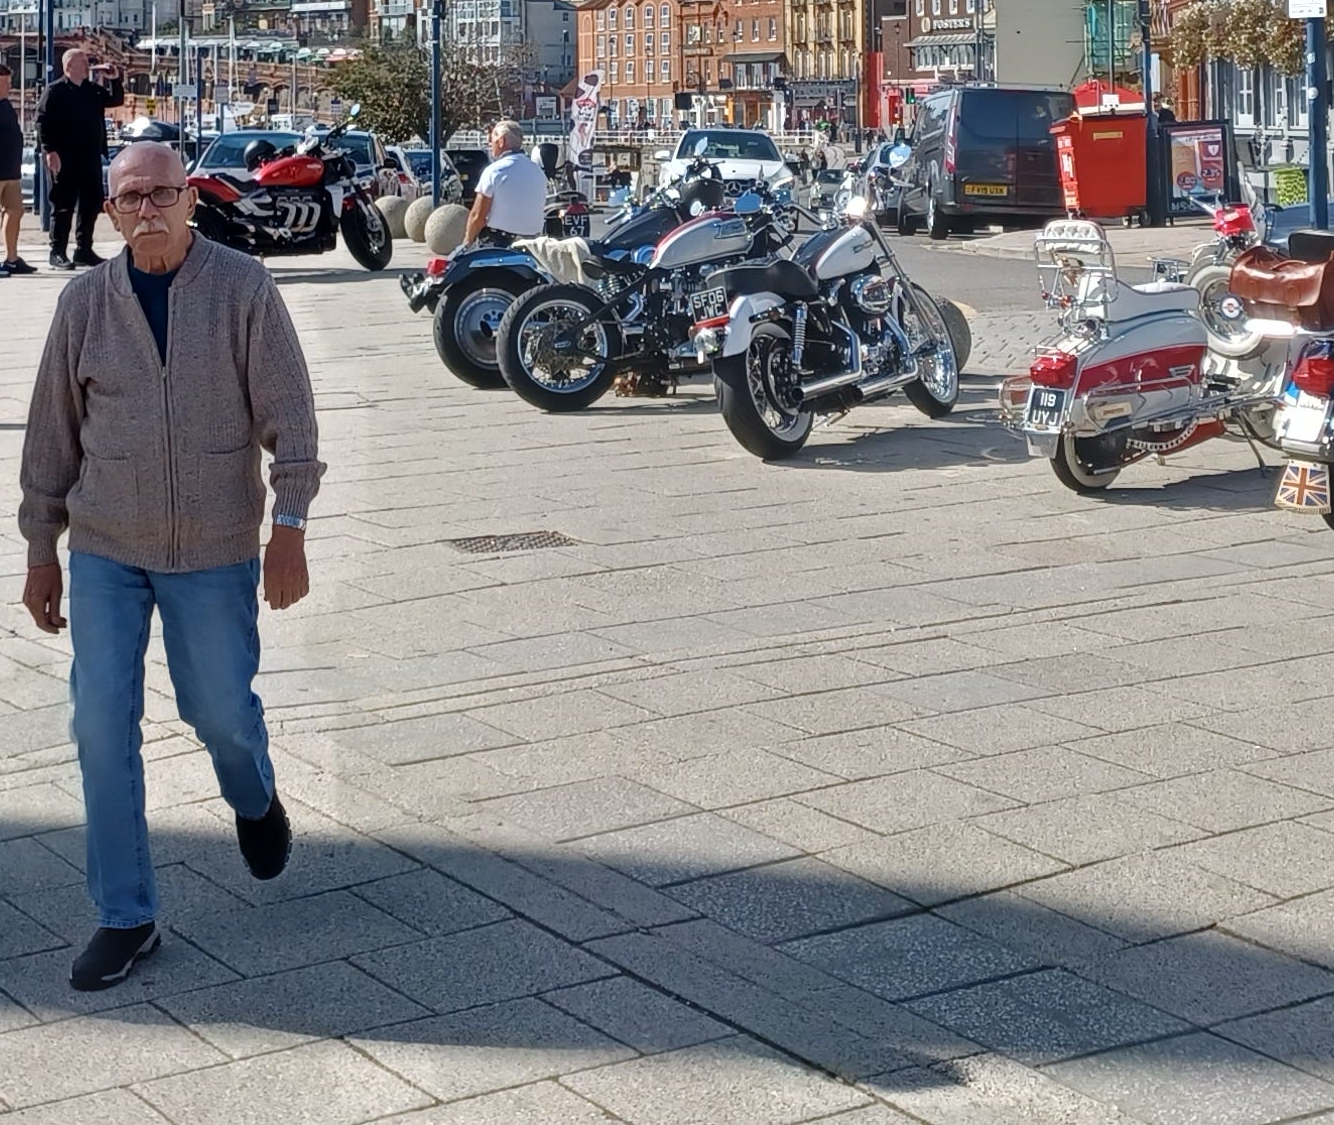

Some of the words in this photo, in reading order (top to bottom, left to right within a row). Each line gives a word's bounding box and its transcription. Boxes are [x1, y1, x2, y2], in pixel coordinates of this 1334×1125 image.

[564, 215, 588, 226] EVF
[569, 225, 586, 236] 67
[693, 290, 724, 310] SF06
[1039, 392, 1057, 408] 119
[1032, 409, 1059, 426] UYJ
